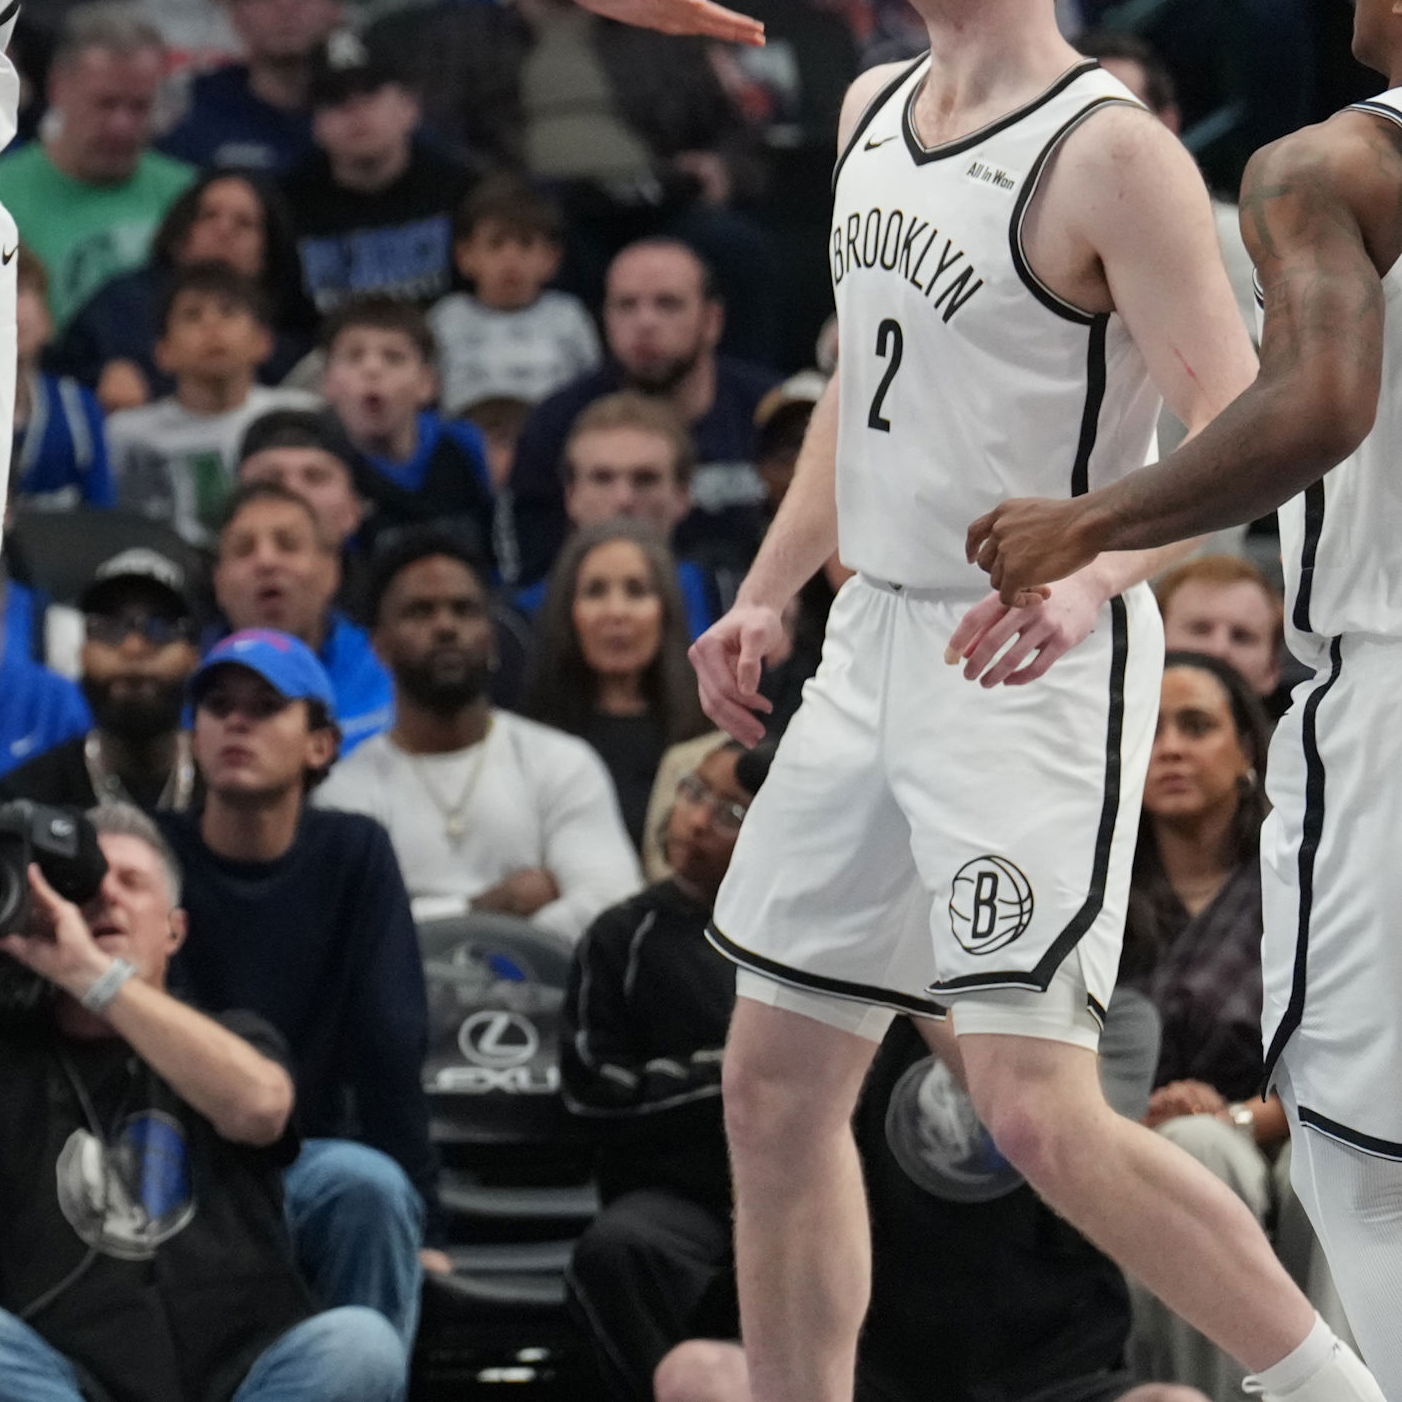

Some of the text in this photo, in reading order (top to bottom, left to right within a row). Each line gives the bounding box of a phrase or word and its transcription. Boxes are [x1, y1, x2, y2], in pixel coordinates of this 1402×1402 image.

[833, 207, 984, 324] BROOKLYN
[868, 318, 903, 433] 2
[972, 871, 998, 938] B
[422, 1065, 561, 1095] EXU
